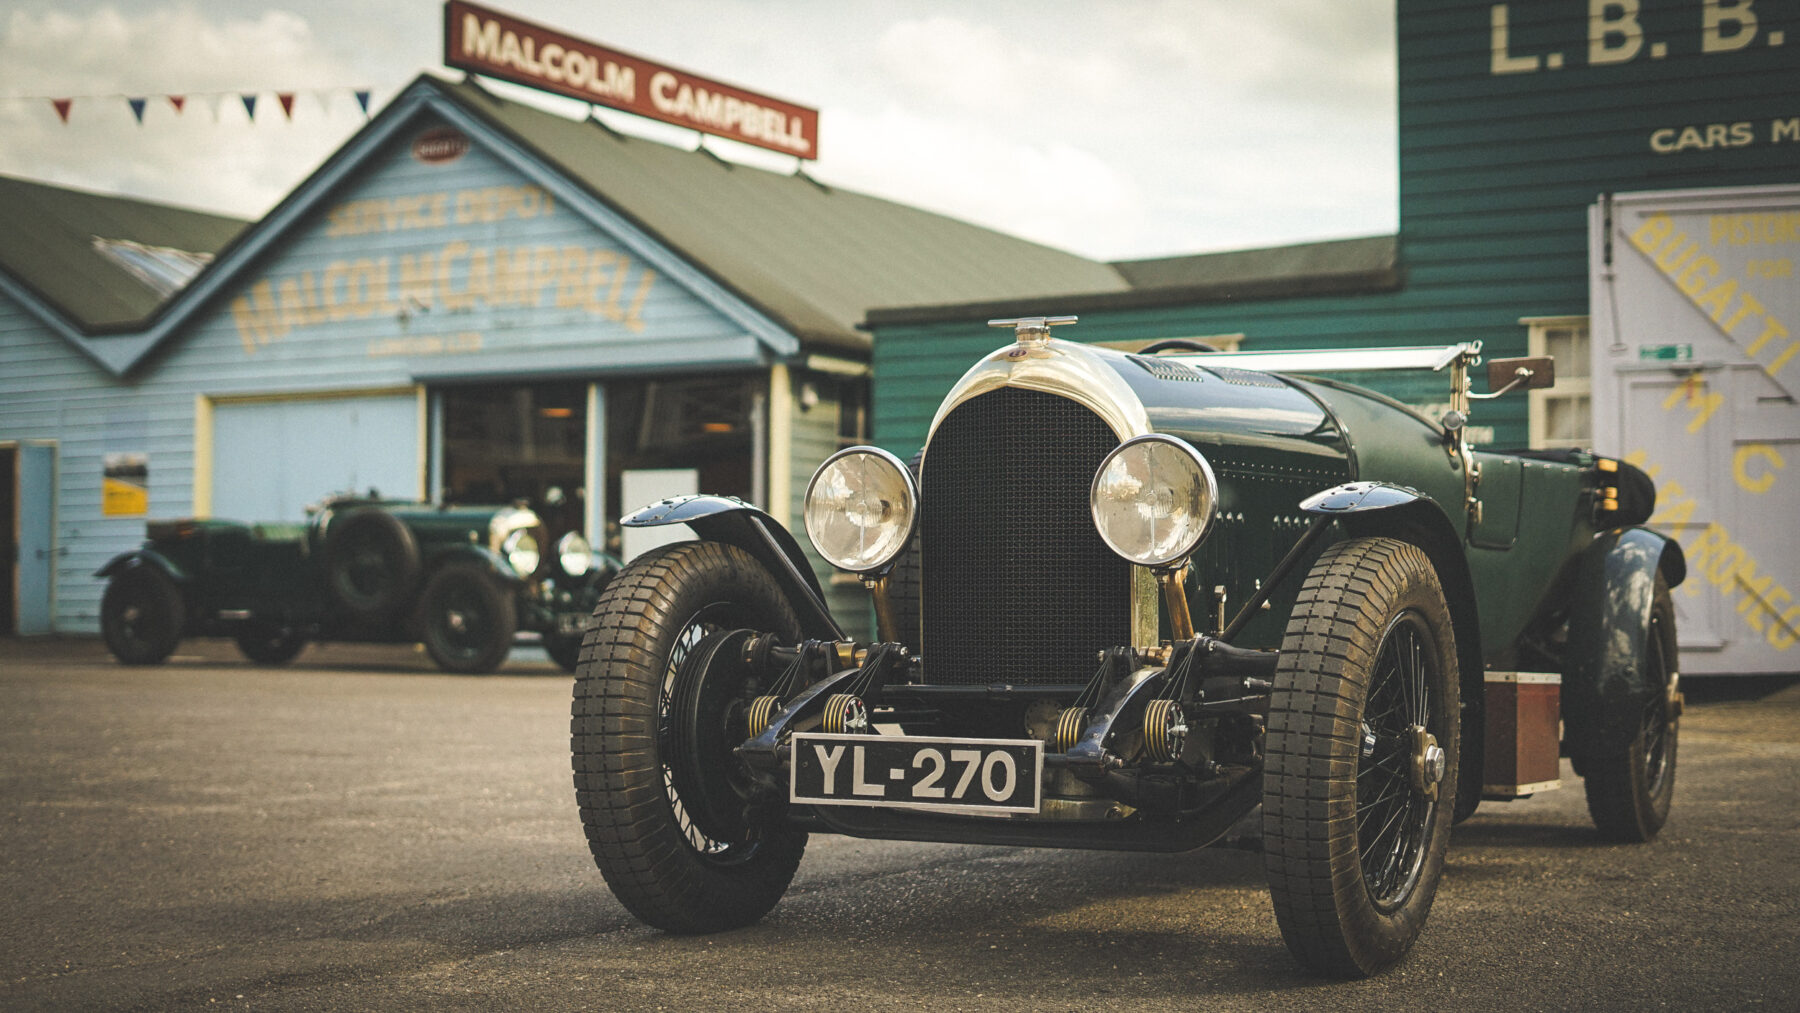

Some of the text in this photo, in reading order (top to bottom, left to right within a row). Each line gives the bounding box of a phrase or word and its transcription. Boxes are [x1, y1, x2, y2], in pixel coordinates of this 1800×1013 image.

[461, 12, 811, 152] MALCOLM CAMPBELL
[1650, 121, 1754, 153] CARS
[438, 239, 656, 333] CAMPBELL
[1630, 209, 1800, 377] BUGATTI
[813, 744, 1017, 802] YL-270
